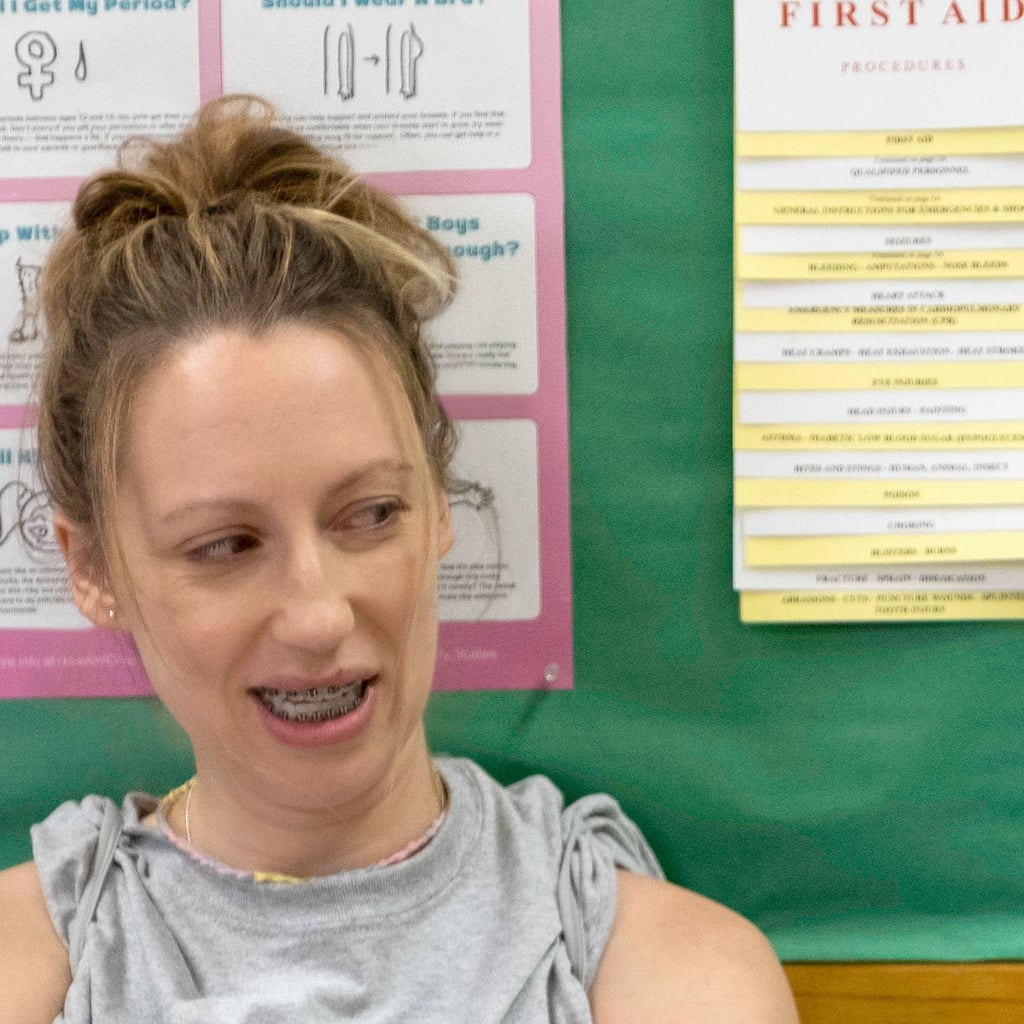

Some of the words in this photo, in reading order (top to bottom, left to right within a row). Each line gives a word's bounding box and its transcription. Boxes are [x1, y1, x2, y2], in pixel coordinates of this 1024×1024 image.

[23, 0, 62, 13] Get
[68, 0, 98, 15] My
[104, 0, 191, 11] Period?
[780, 0, 926, 28] FIRST
[840, 57, 968, 74] PROCEDURES
[427, 216, 479, 234] Boys
[448, 241, 519, 260] ough?
